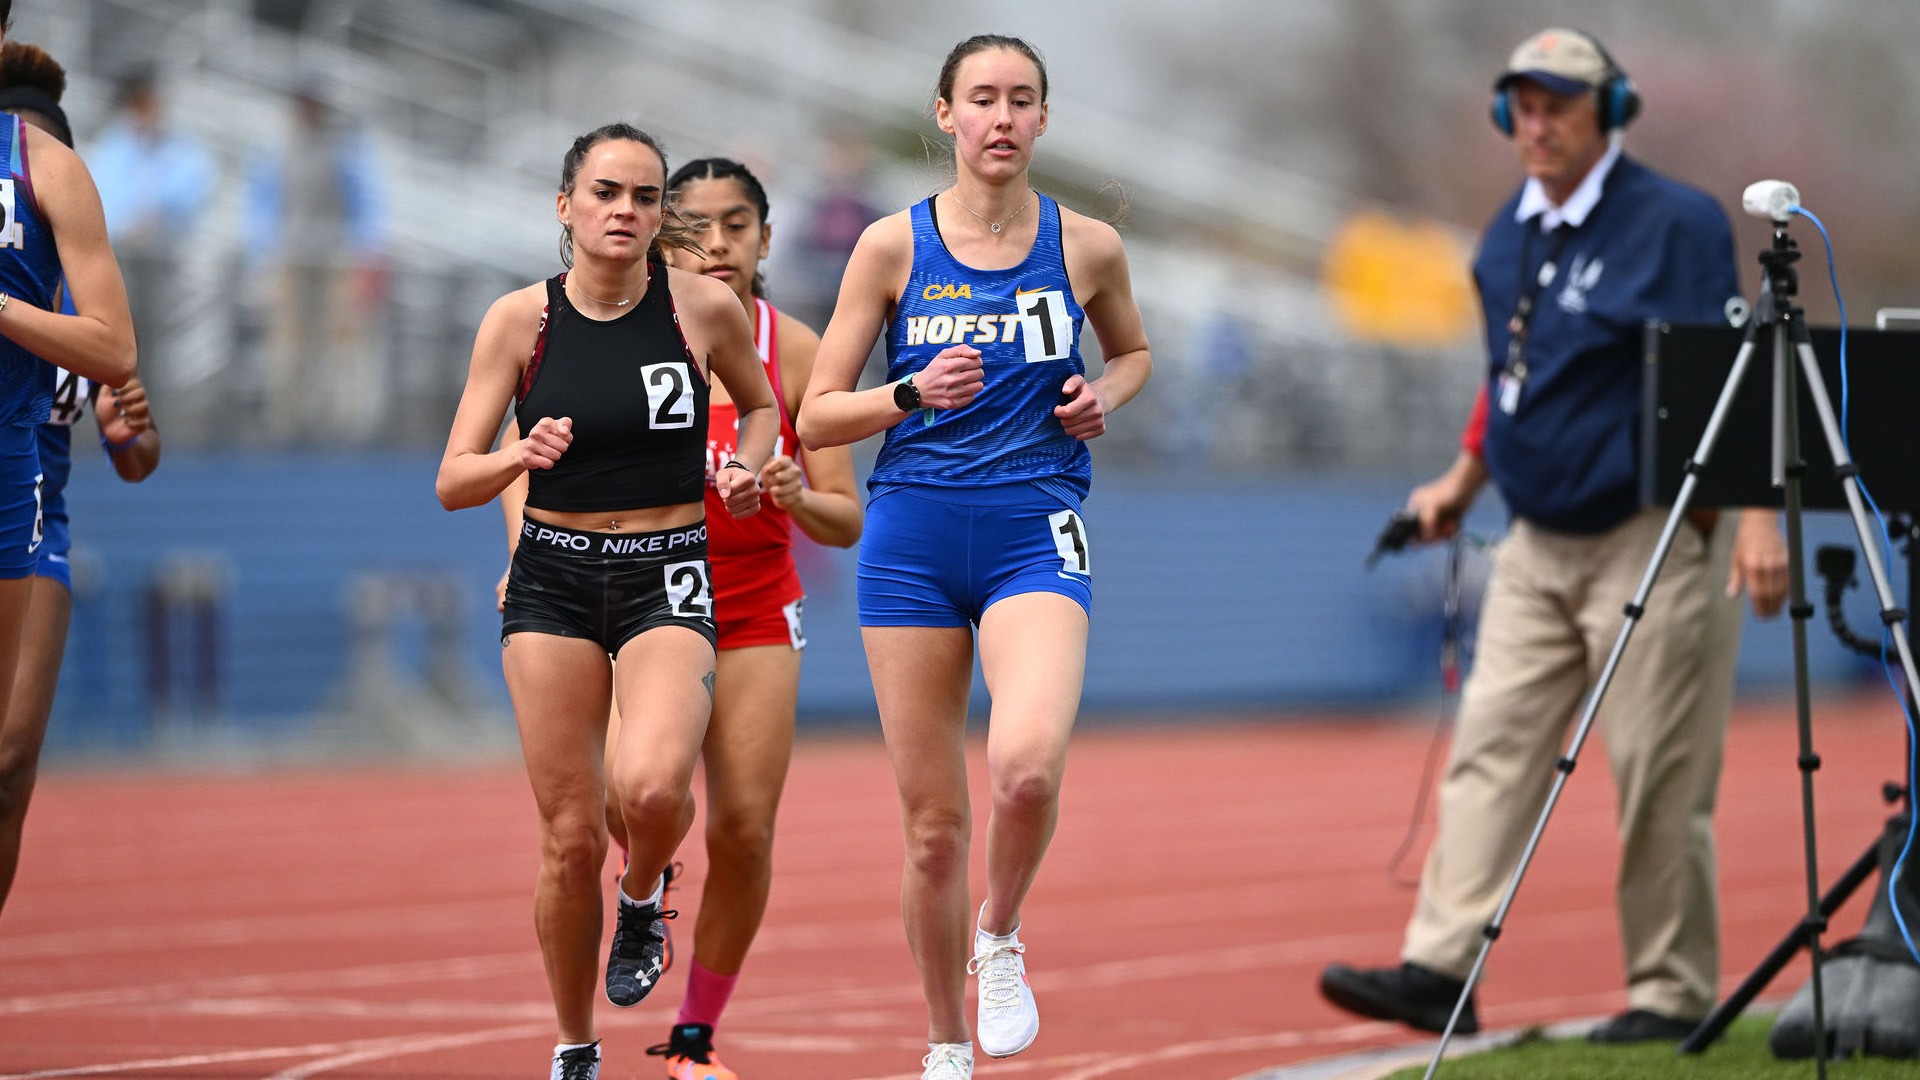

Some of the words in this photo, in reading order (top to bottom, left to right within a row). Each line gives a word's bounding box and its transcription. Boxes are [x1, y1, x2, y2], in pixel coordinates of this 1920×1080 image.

[923, 284, 972, 300] CAA
[907, 314, 1073, 346] HOFST
[1026, 297, 1057, 356] 1
[650, 366, 688, 424] 2
[536, 528, 590, 550] PRO
[601, 536, 665, 554] NIKE
[668, 525, 707, 549] PRO
[1059, 514, 1086, 570] 1
[671, 566, 707, 615] 2
